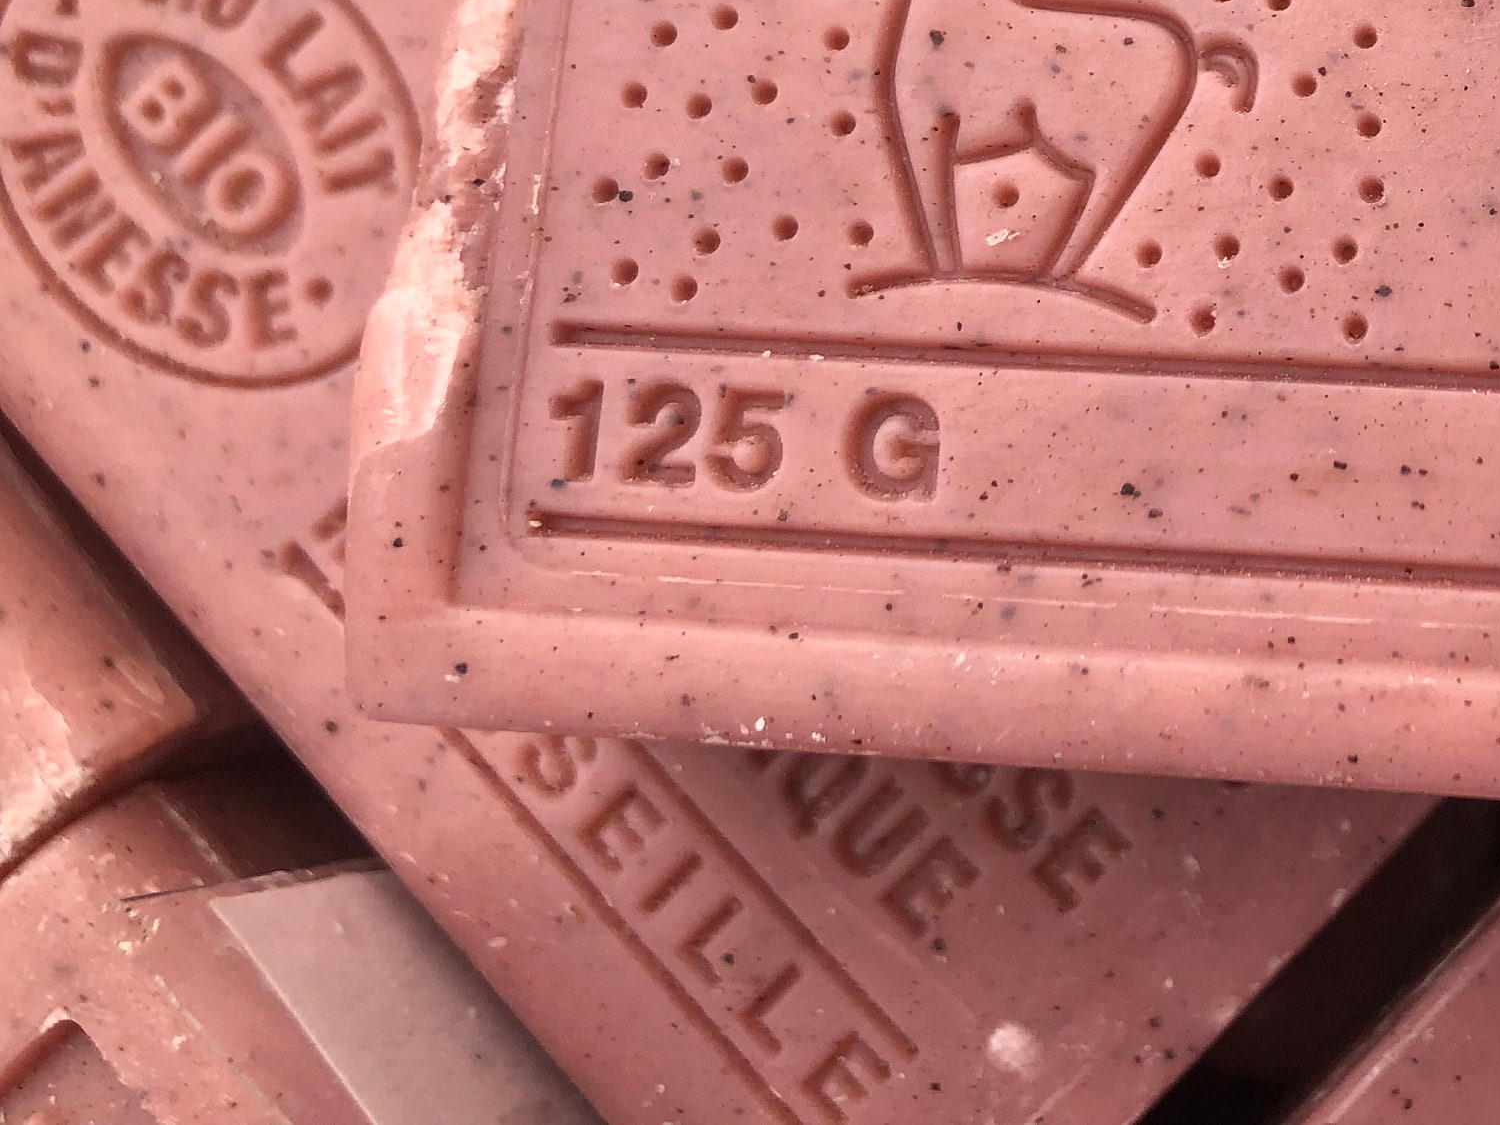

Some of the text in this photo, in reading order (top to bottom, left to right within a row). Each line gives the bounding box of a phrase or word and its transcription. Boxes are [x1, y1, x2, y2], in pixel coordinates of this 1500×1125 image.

[6, 27, 300, 352] D'ANESSE
[120, 58, 300, 239] BIO
[258, 9, 400, 197] LAIT
[548, 378, 942, 503] 125 G
